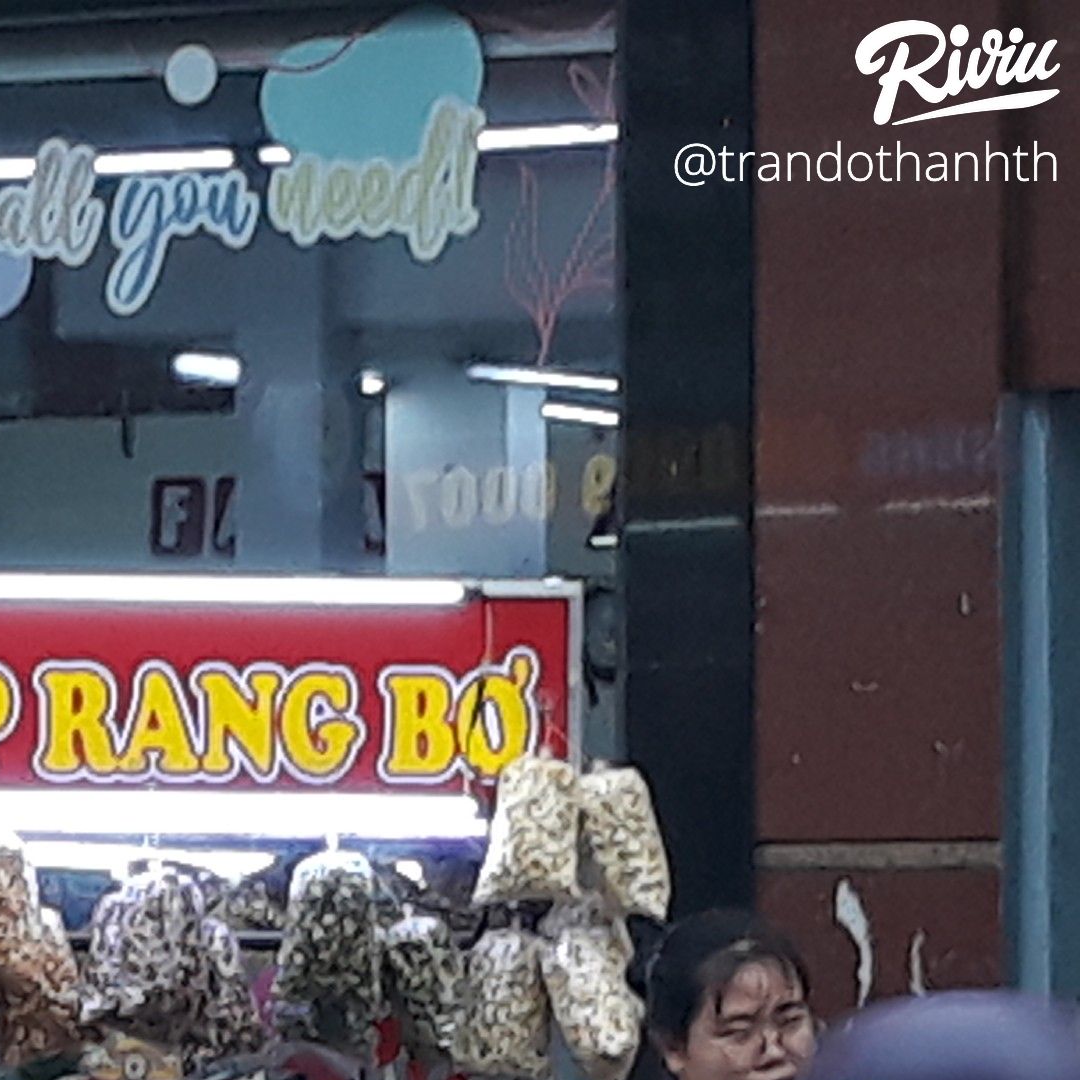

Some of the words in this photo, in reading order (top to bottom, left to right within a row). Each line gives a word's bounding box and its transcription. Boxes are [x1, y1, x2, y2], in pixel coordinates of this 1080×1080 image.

[106, 168, 258, 314] you
[267, 105, 486, 261] need
[35, 661, 364, 783] RANG
[380, 648, 538, 783] BƠ
